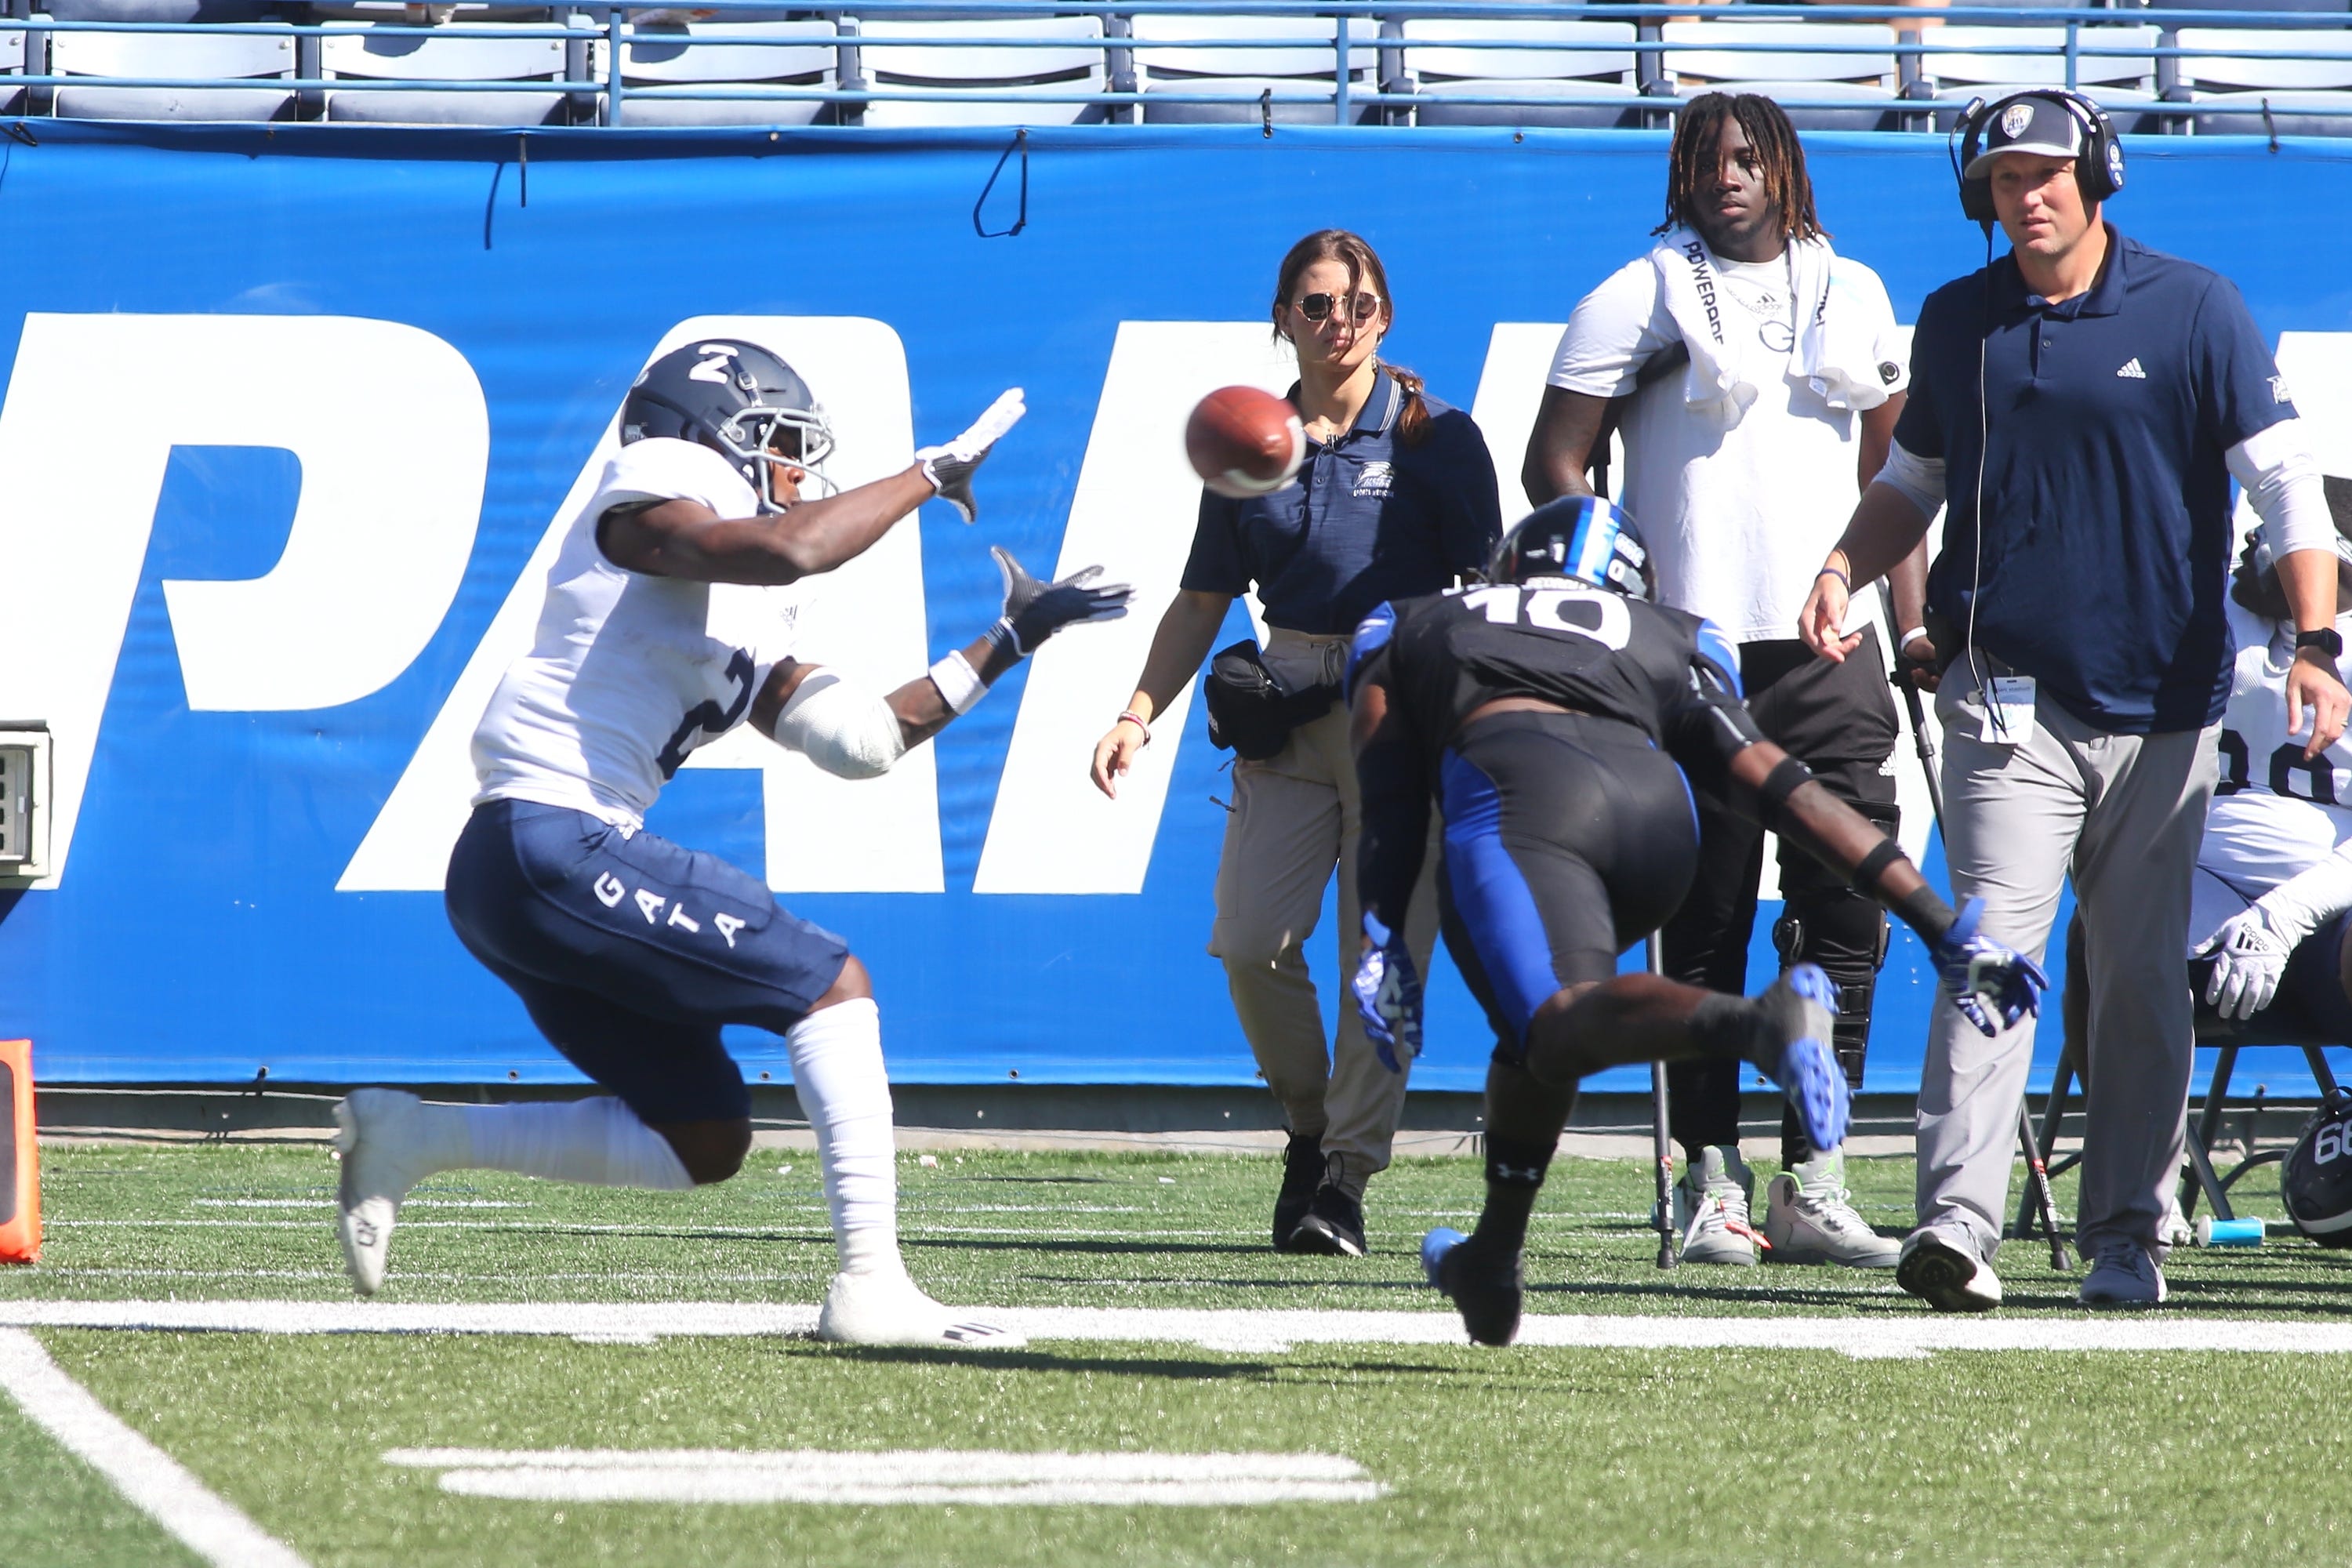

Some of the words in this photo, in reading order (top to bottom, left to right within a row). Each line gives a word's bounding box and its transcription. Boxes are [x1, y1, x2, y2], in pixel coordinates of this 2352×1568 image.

[688, 343, 739, 385] 2
[2117, 369, 2147, 379] adidas
[1461, 586, 1632, 652] 10
[655, 647, 755, 780] 2
[593, 870, 746, 949] GATA
[2241, 922, 2270, 952] adidas
